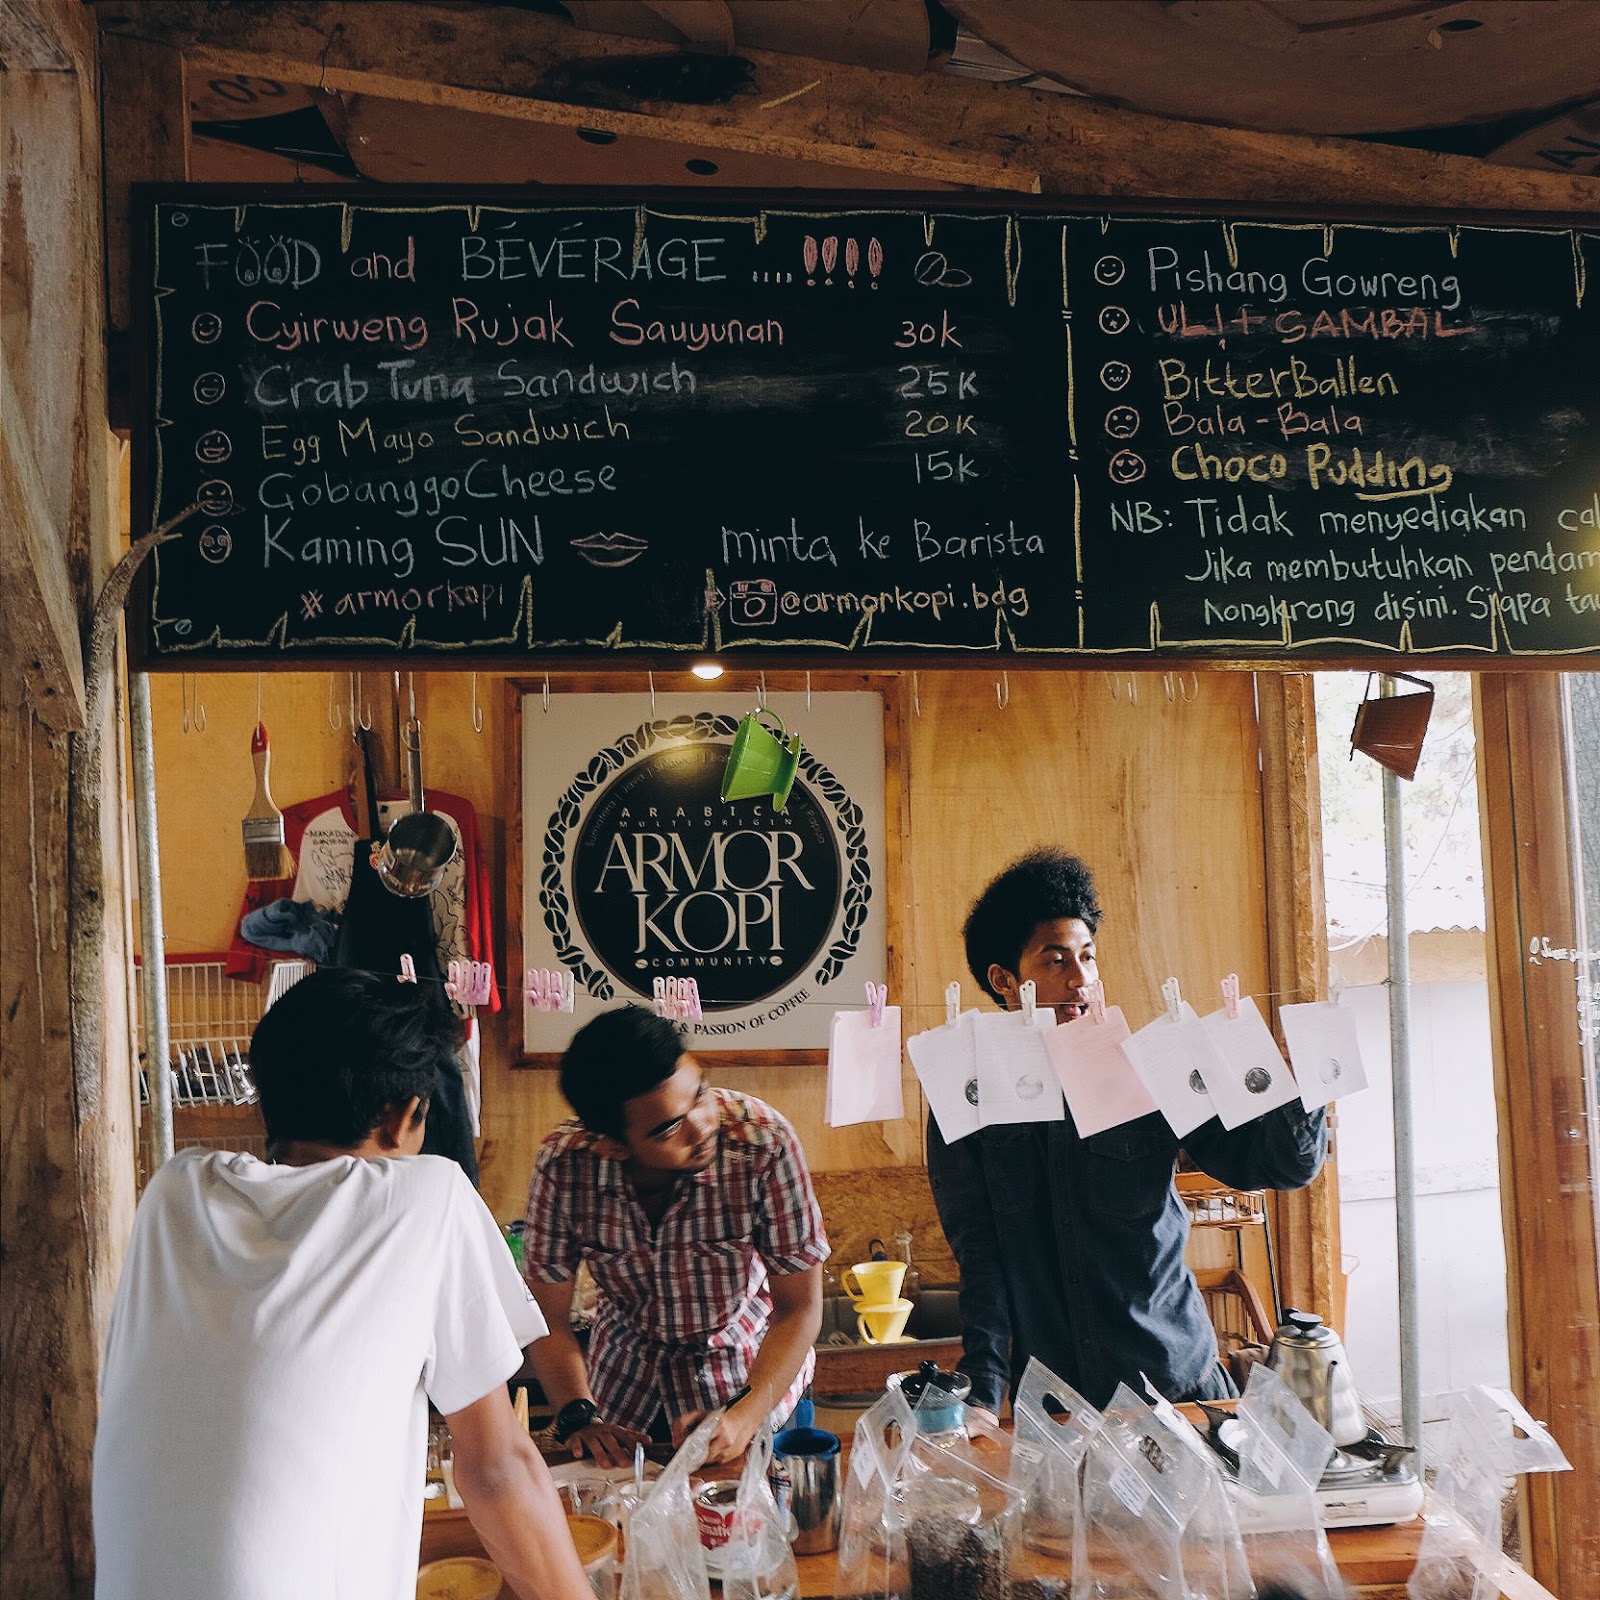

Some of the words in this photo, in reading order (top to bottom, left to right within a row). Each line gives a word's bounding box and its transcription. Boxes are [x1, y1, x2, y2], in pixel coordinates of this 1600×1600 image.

[350, 235, 417, 283] and
[1148, 246, 1288, 303] Pishang
[1302, 257, 1462, 311] Gowreng
[246, 300, 429, 351] Cyirweng
[453, 297, 575, 348] Rujak
[609, 298, 784, 351] Sauyunan
[1274, 305, 1476, 344] SAMBAL
[253, 362, 369, 409] Crab
[378, 359, 478, 404] Tuna
[497, 359, 698, 398] Sandwich
[261, 424, 321, 466] Egg
[338, 416, 434, 464] Mayo
[454, 405, 632, 448] Sandwich
[1171, 442, 1288, 483] Choco
[1305, 442, 1454, 496] Pudding
[1110, 499, 1174, 534] NB:
[1184, 493, 1294, 540] Tidak
[1319, 493, 1527, 542] menyediakan
[263, 514, 416, 579] Kaming
[435, 514, 545, 567] SUN
[858, 515, 891, 560] ke
[913, 518, 1046, 563] Barista
[1185, 546, 1252, 584] Jika
[1267, 545, 1474, 583] membutuhkan
[780, 581, 1031, 621] @armorkopi.bdg
[1374, 584, 1459, 622] disini.
[1466, 584, 1552, 625] Siapa
[621, 805, 790, 818] ARABICA
[593, 829, 816, 893] ARMOR
[633, 885, 785, 953] KOPI
[652, 955, 768, 968] COMMUNITY
[694, 1020, 747, 1036] PASSION
[749, 1014, 767, 1029] OF
[768, 988, 812, 1021] COFFEE
